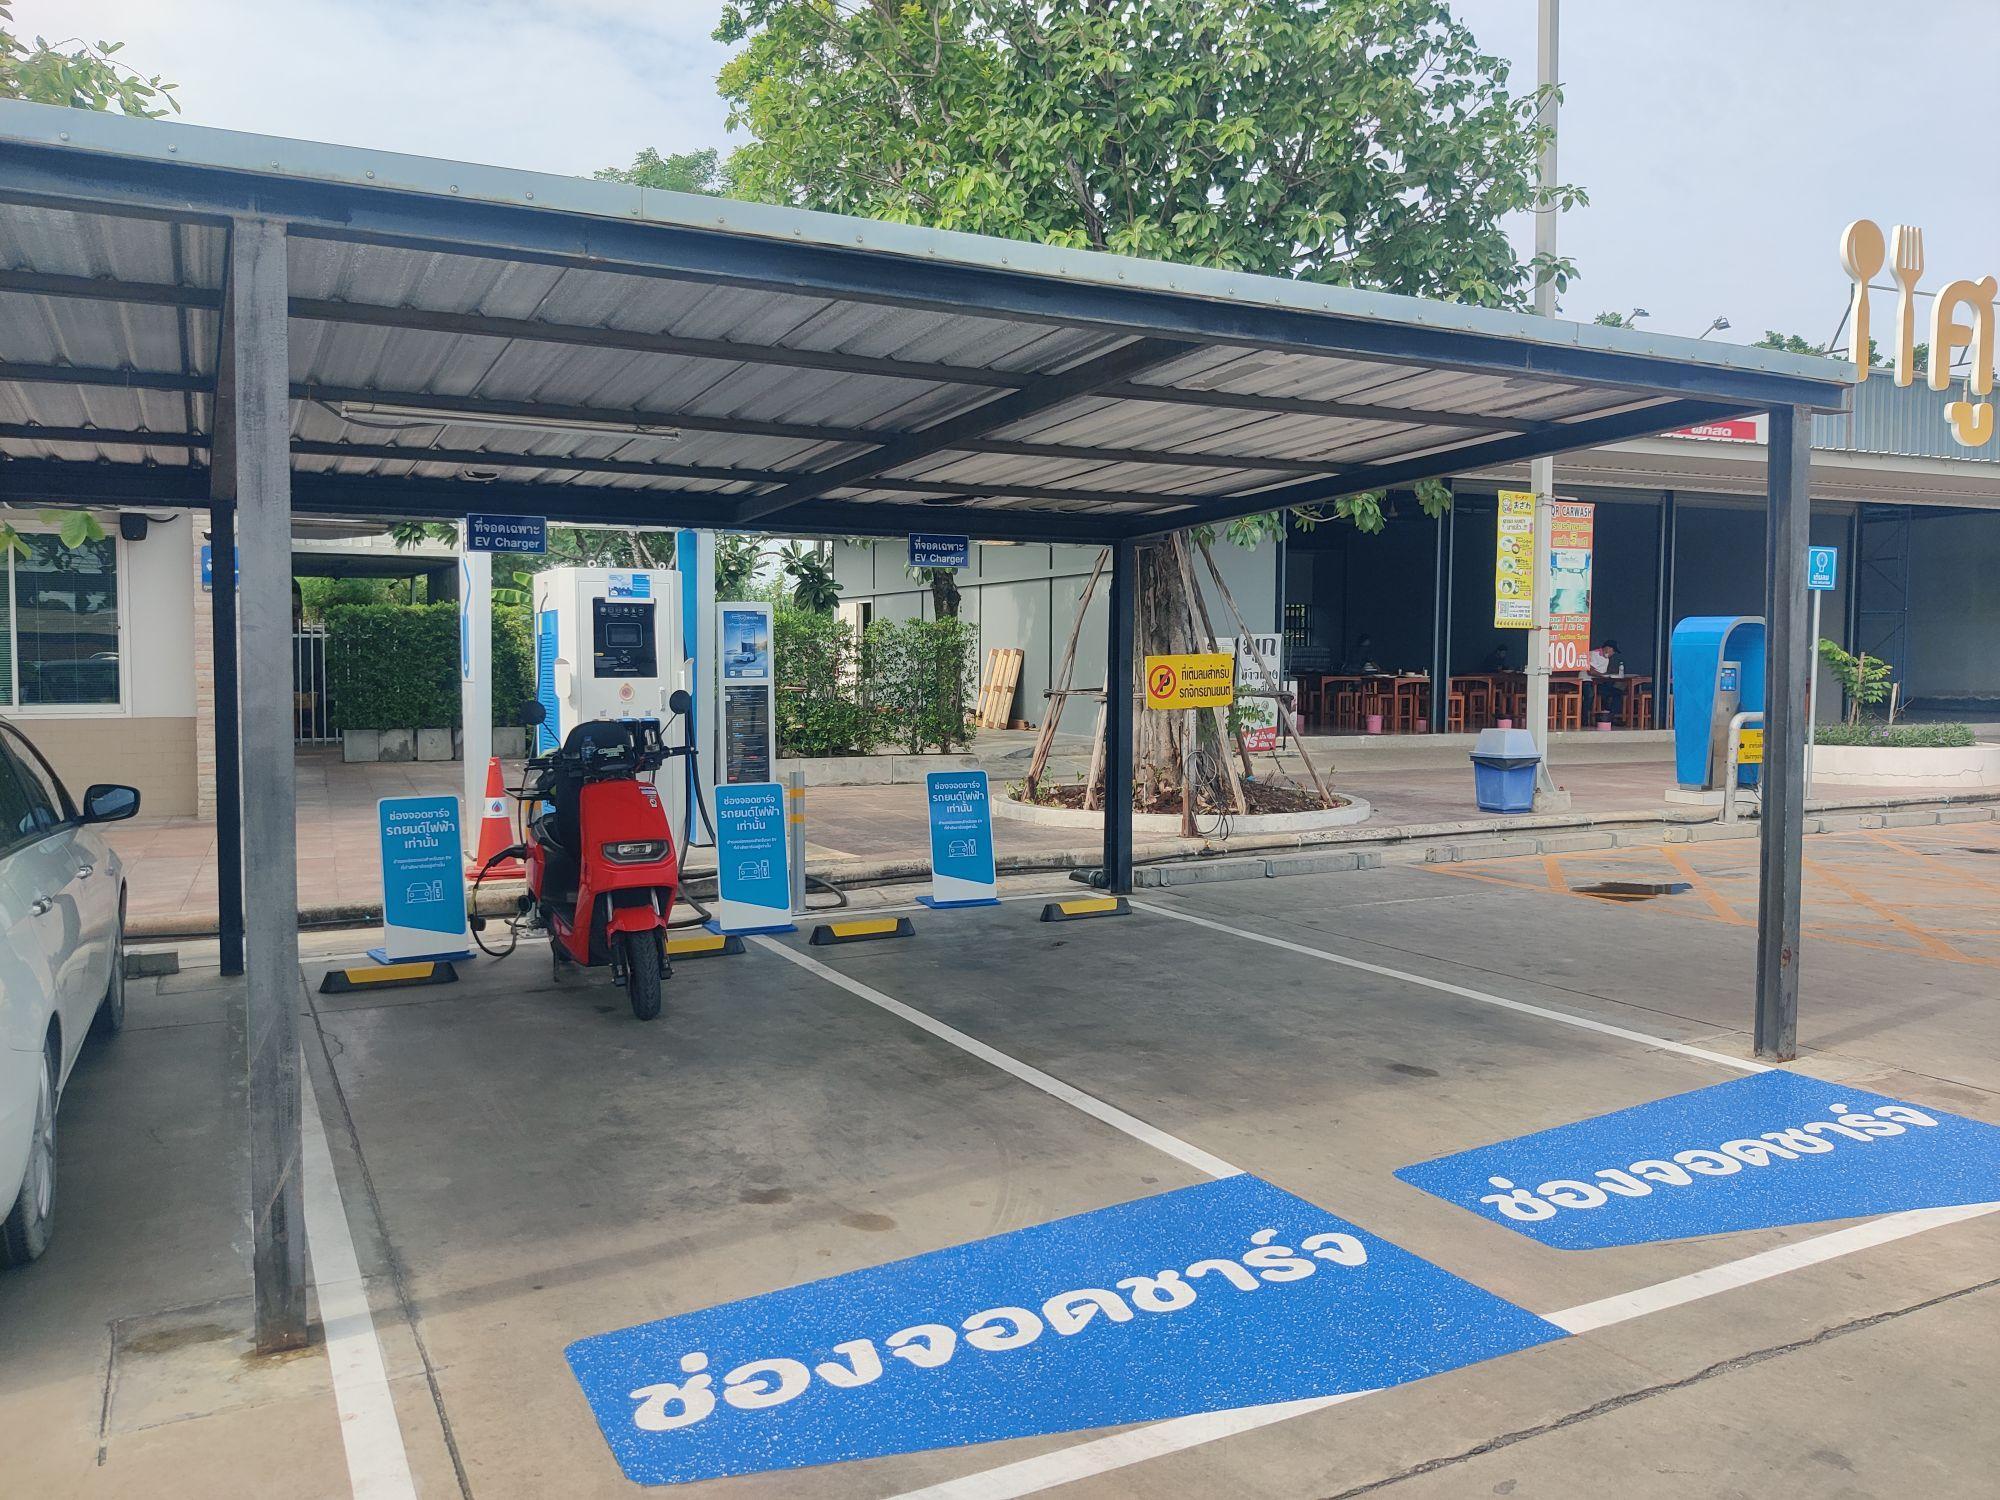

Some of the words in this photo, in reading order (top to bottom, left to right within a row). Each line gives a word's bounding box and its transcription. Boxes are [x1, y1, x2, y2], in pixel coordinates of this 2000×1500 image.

[1562, 506, 1591, 517] CARWASH
[474, 516, 540, 535] ที่จอดเฉพาะ
[475, 537, 490, 547] EV
[495, 537, 540, 550] Charger
[914, 536, 964, 551] ที่จอดเฉพาะ
[914, 553, 926, 562] EV
[930, 554, 964, 565] Charger
[1549, 642, 1576, 668] 100
[1181, 663, 1230, 680] ที่เติมลมสำหรับ
[1179, 681, 1231, 698] รถจักรยานยนต์
[934, 781, 980, 790] ช่องจอดชาร์จ
[723, 794, 775, 805] ช่องจอดชาร์จ
[932, 790, 984, 802] รถยนต์ไฟฟ้า
[389, 808, 450, 820] ช่องจอดชาร์จ
[721, 805, 780, 819] รถยนต์ไฟฟ้า
[946, 800, 972, 813] เท่านั้น
[386, 820, 455, 836] รถยนต์ไฟฟ้า
[736, 816, 766, 831] เท่านั้น
[404, 833, 439, 848] เท่านั้น
[1480, 1104, 1938, 1222] ช่องจอดชาร์จ
[629, 1229, 1368, 1431] ช่องจอดชาร์จ
